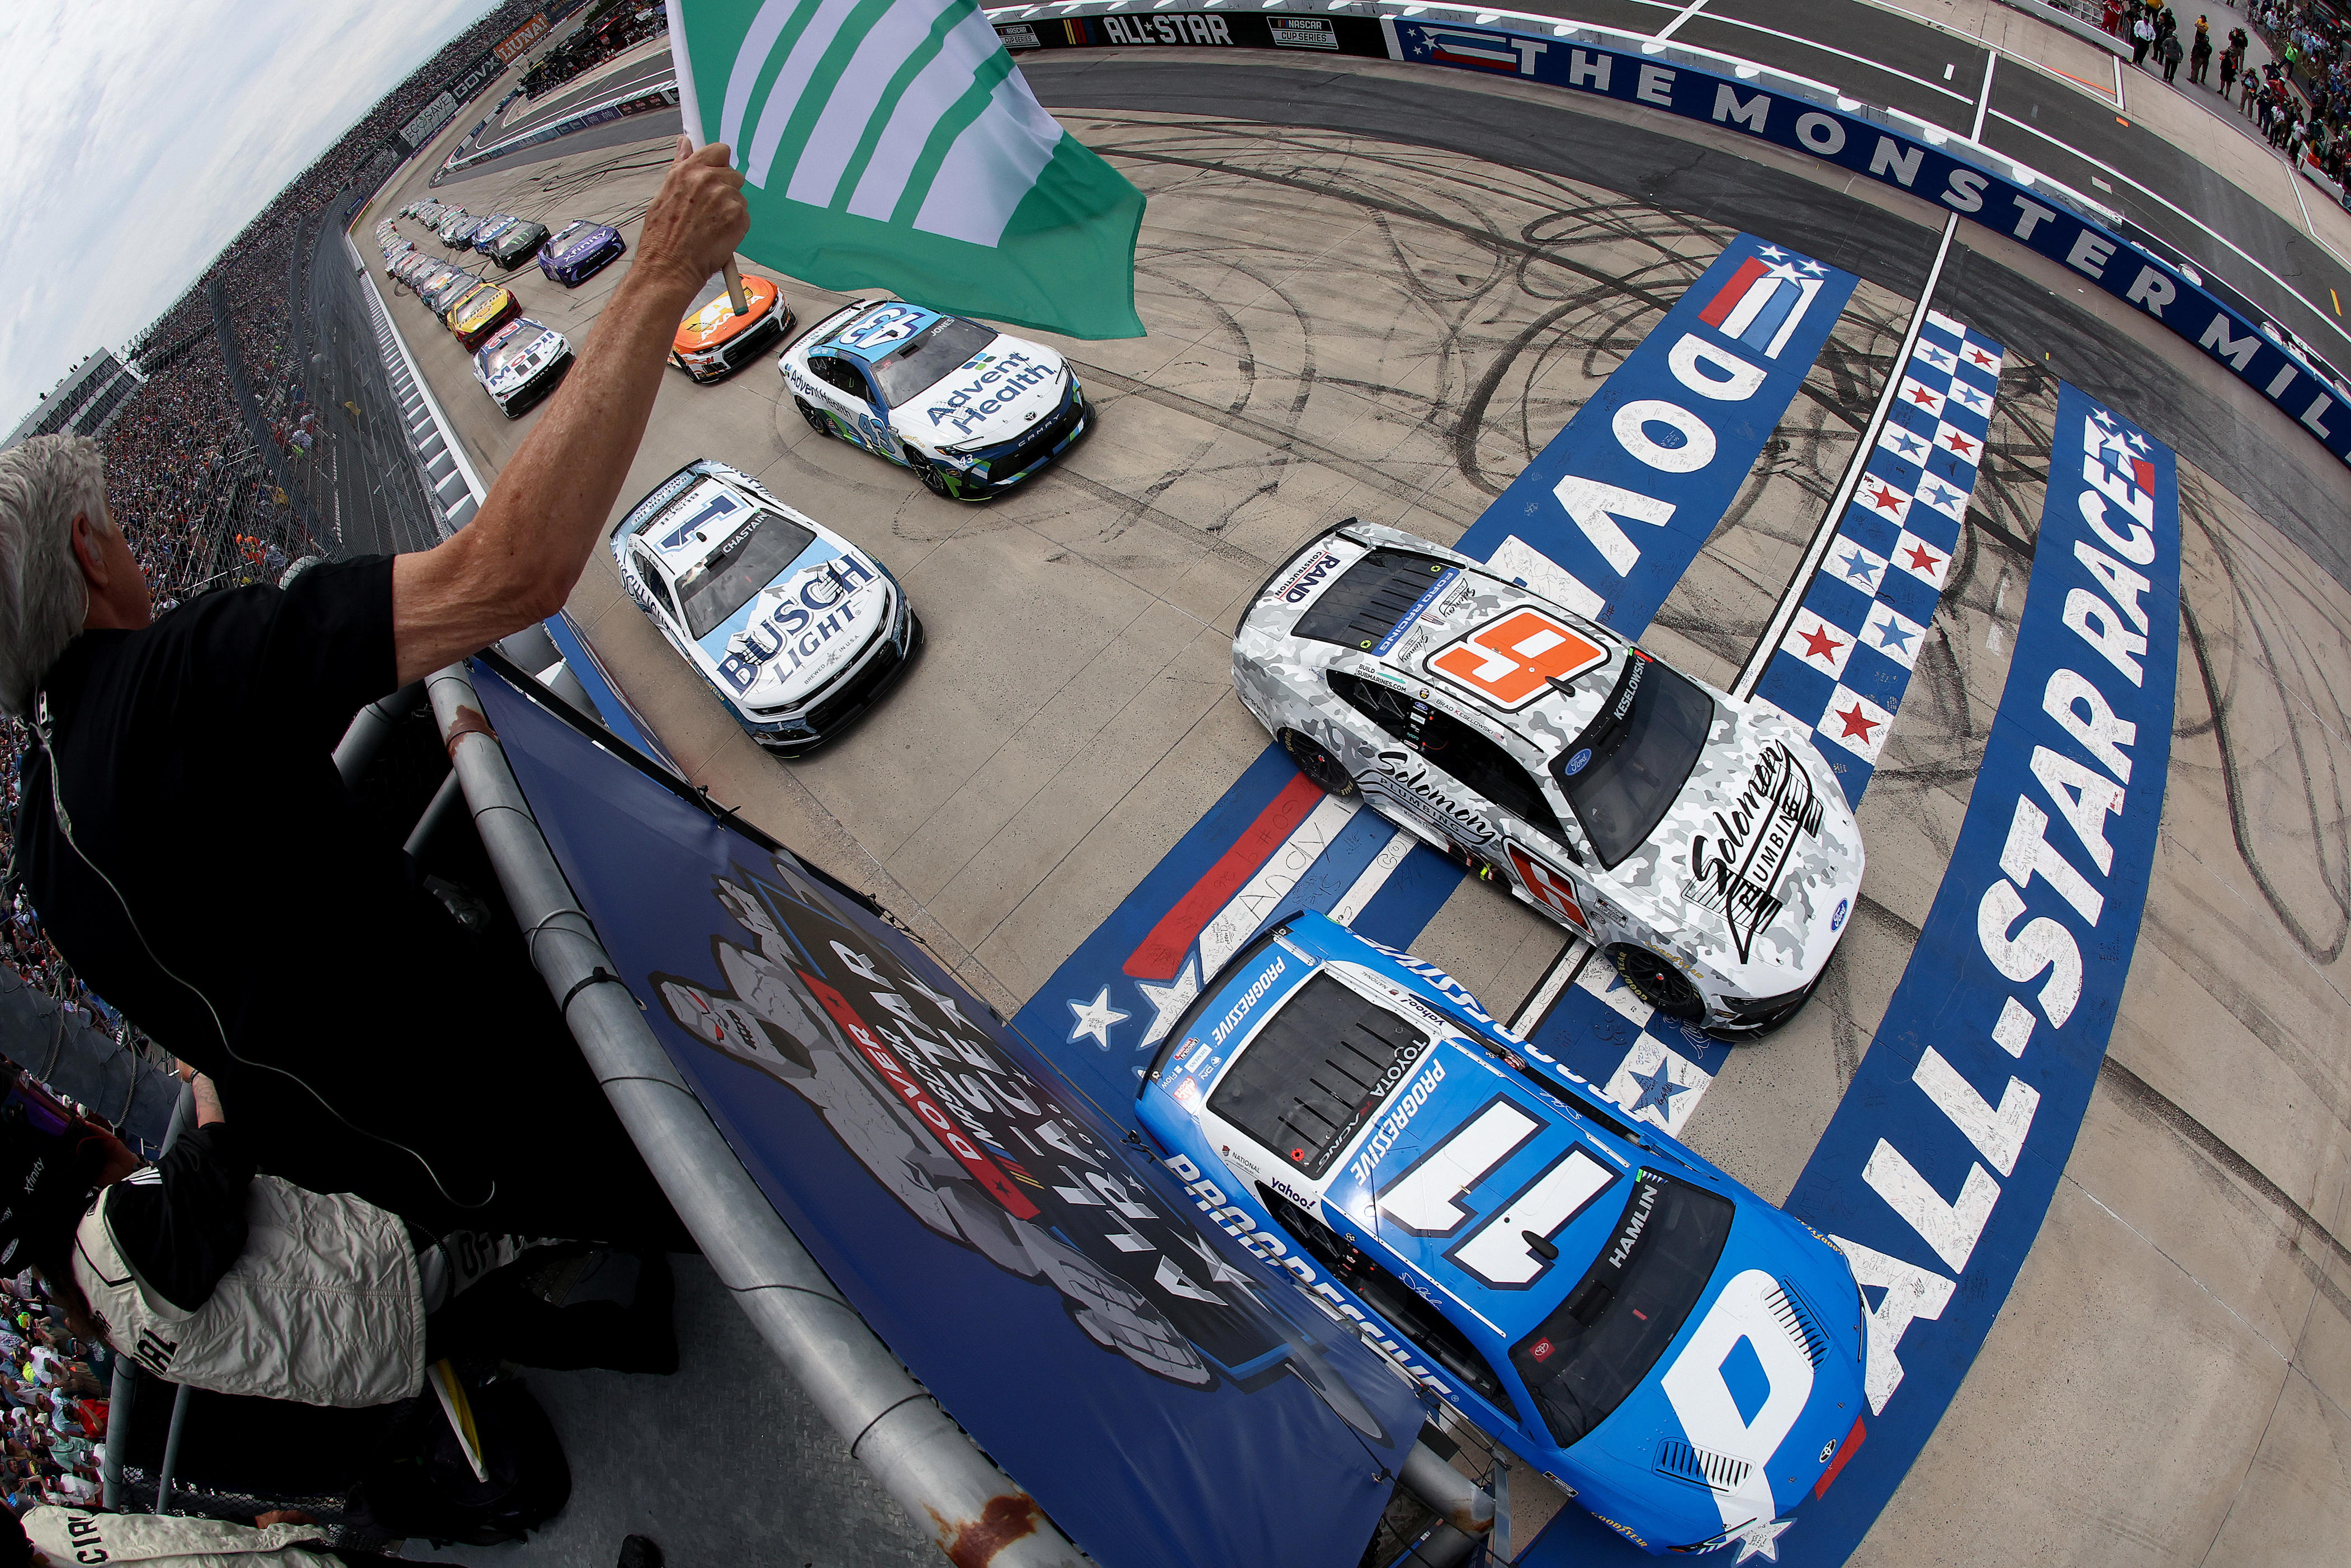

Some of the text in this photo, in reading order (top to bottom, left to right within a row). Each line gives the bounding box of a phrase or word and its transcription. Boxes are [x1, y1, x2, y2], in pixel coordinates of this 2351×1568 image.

[1281, 31, 1327, 42] CUP SERIES
[1288, 20, 1322, 30] NASCAR
[453, 56, 500, 99] GOVX
[373, 148, 389, 165] NASCAR
[564, 230, 607, 263] xfinity
[585, 249, 605, 263] CAMRY
[1512, 40, 2351, 460] THE MONSTER MIL
[701, 295, 765, 342] AXAA
[839, 307, 926, 350] 43
[931, 318, 955, 337] JONES
[490, 331, 555, 387] Mobil
[526, 368, 550, 388] CAMRY
[790, 369, 853, 420] AdventHealth
[927, 352, 1030, 427] Advent
[951, 364, 1054, 435] Health
[858, 413, 895, 454] 43
[901, 433, 926, 448] GOODYEAR
[1018, 413, 1061, 447] CAMRY
[959, 454, 974, 466] 43
[722, 510, 771, 554] CHASTAIN
[1274, 552, 1322, 596] CONSTRUCTION
[1286, 554, 1341, 604] RAND
[1379, 571, 1454, 651] FORD RACING
[1444, 585, 1465, 607] PLUMBING
[717, 553, 878, 698] BUSCH
[773, 600, 857, 685] LIGHT
[1401, 631, 1423, 653] PLUMBING
[804, 664, 826, 685] BREWED
[845, 635, 861, 647] U.S.A.
[1358, 664, 1375, 674] BUILD
[1356, 670, 1407, 693] SUBMARINES.COM
[1614, 655, 1646, 721] KESELOWSKI
[1436, 699, 1494, 735] BRAD KESELOWSKI
[1568, 749, 1590, 774] Ford
[1341, 780, 1354, 796] EAGLE
[1378, 751, 1496, 840] Solomon
[1380, 776, 1460, 833] PLUMBING
[1692, 741, 1786, 896] Solomon
[1827, 413, 2156, 1417] ALL-STAR RACE
[1832, 901, 1847, 930] Ford
[1360, 970, 1388, 991] NATIONAL
[1645, 941, 1704, 980] GOODYEAR
[1211, 955, 1286, 1046] PROGRESSIVE
[1399, 997, 1446, 1027] yahoo!
[1516, 1014, 1535, 1033] #2
[1174, 1039, 1193, 1059] WELDERS
[1181, 1037, 1200, 1060] LINCOLN
[1189, 1048, 1208, 1068] SIEMENS
[1369, 1039, 1427, 1098] TOYOTA
[848, 1022, 983, 1160] DOVER
[875, 1024, 1004, 1150] NASCAR
[1161, 1071, 1178, 1089] Flow
[1174, 1077, 1191, 1097] TOOLS
[829, 939, 1229, 1306] ALL-STAR
[936, 1027, 1160, 1220] RACE
[1046, 1102, 1110, 1159] 2026
[1350, 1058, 1447, 1187] PROGRESSIVE
[23, 1157, 45, 1195] xfinity
[1232, 1152, 1260, 1174] NATIONAL
[1271, 1177, 1317, 1210] yahoo!
[1370, 1092, 1625, 1291] 11
[1609, 1183, 1659, 1269] HAMLIN
